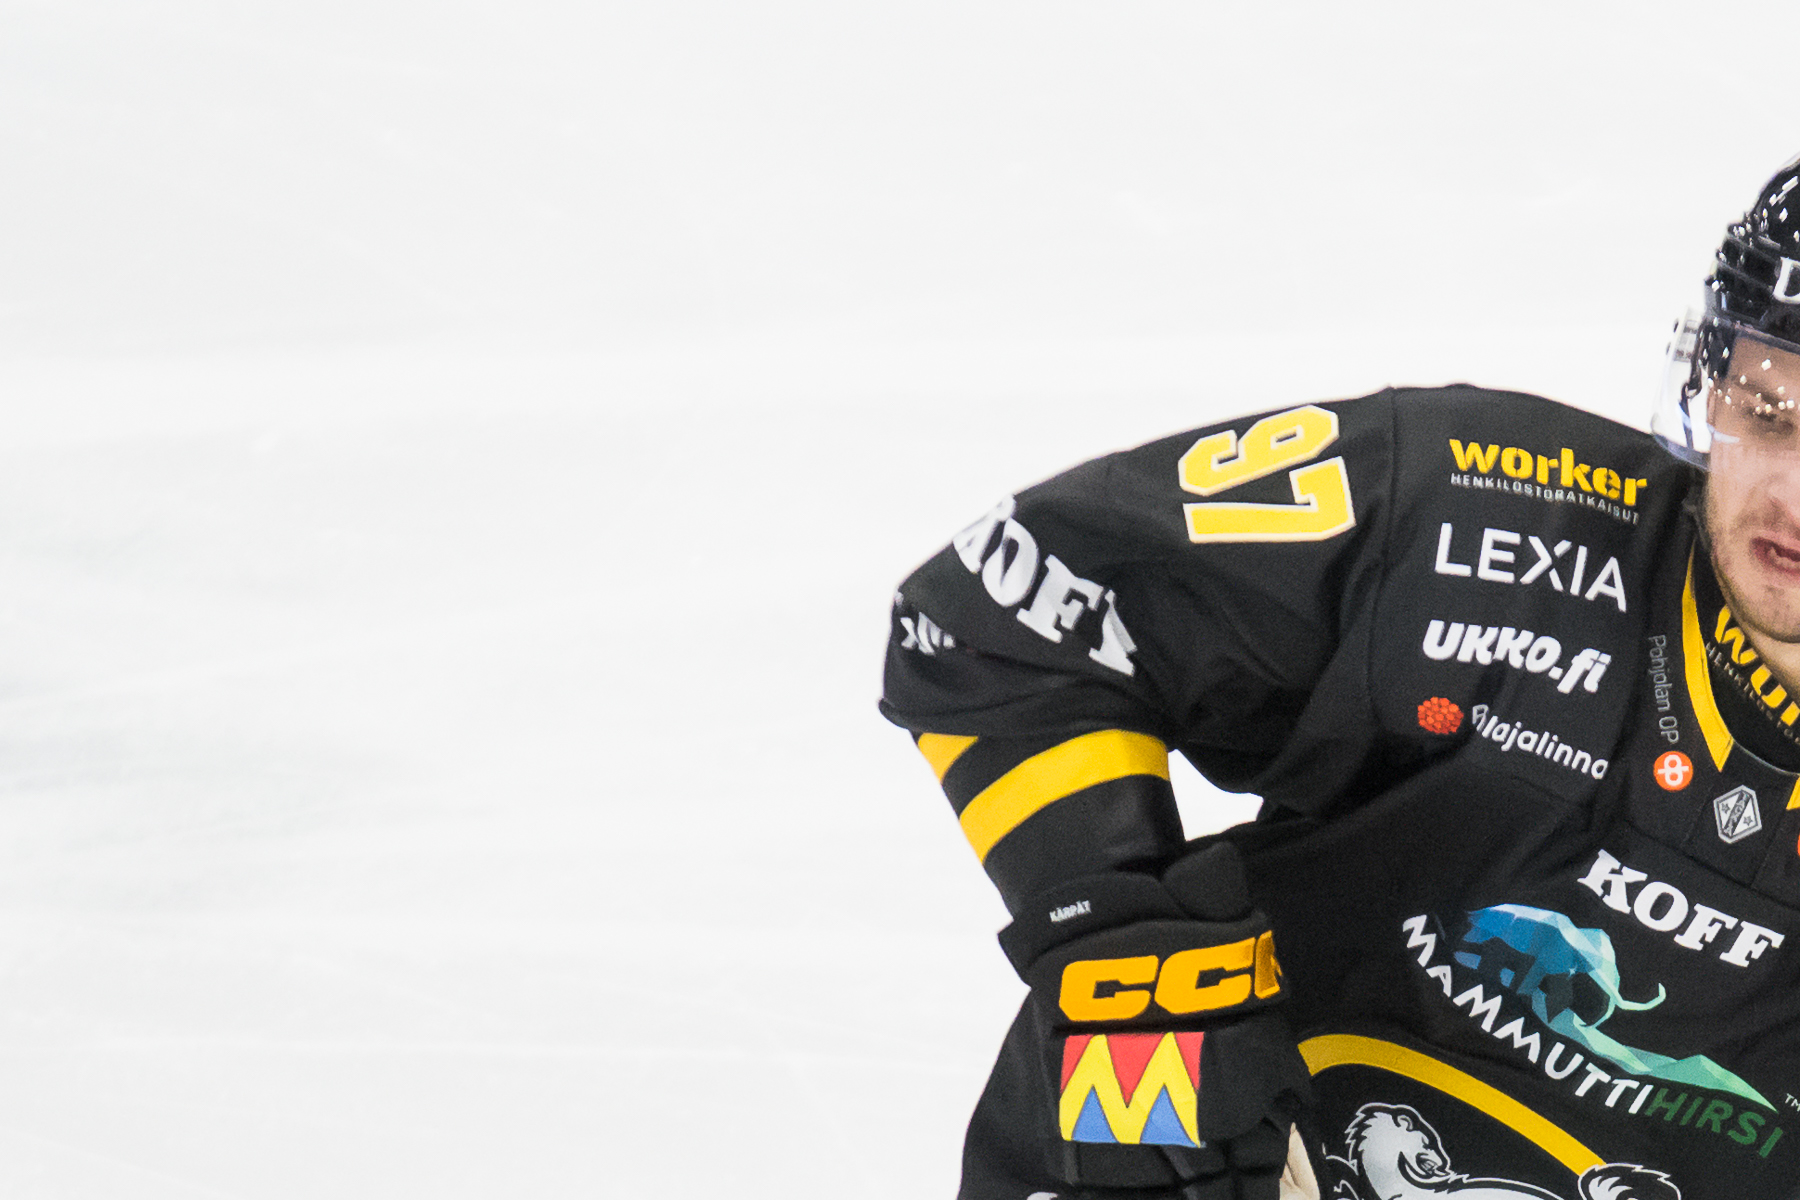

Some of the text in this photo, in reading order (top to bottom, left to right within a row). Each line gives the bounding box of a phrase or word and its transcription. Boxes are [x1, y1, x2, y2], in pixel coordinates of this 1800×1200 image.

[1178, 404, 1356, 543] 97
[1449, 438, 1648, 506] worker
[1435, 522, 1627, 613] LEXIA
[1648, 634, 1680, 745] Pohjolan OP
[1577, 849, 1785, 968] KOFF
